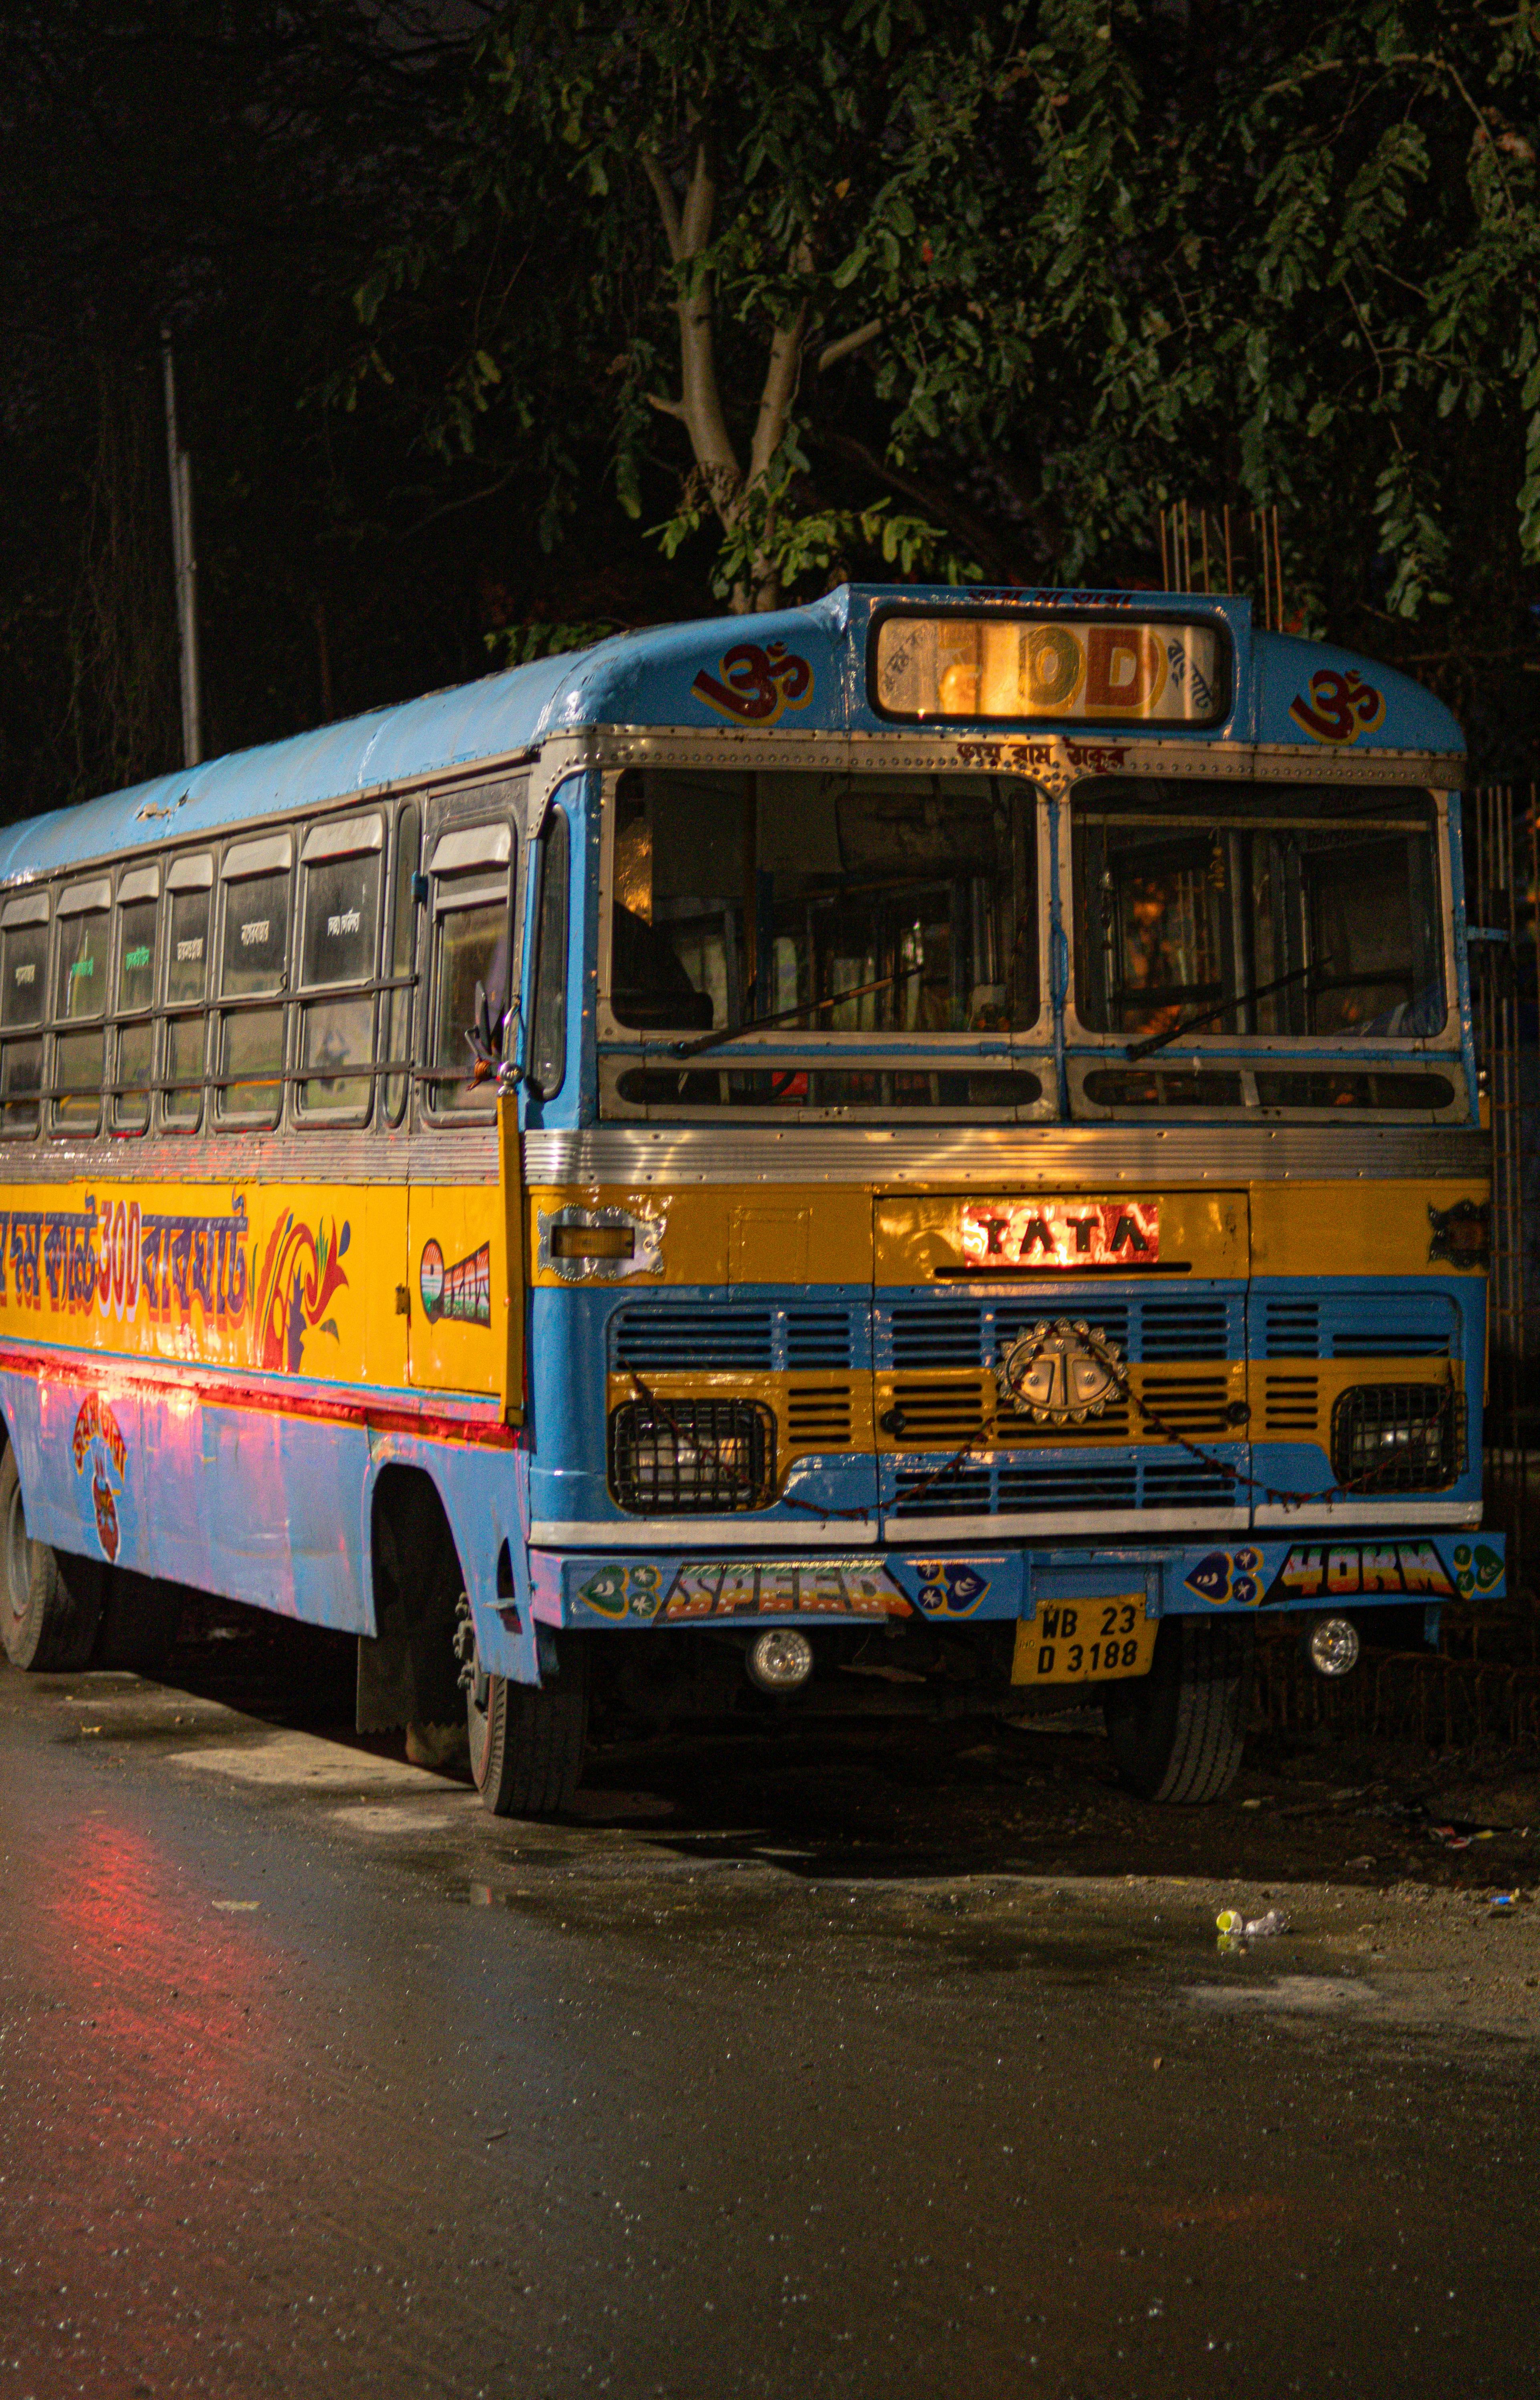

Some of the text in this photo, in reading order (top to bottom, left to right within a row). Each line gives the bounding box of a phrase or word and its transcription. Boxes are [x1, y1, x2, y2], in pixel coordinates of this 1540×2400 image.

[978, 1216, 1149, 1254] TATA
[659, 1562, 918, 1622] SPEED
[1042, 1605, 1136, 1639] WB 23
[1038, 1639, 1138, 1674] D 3188
